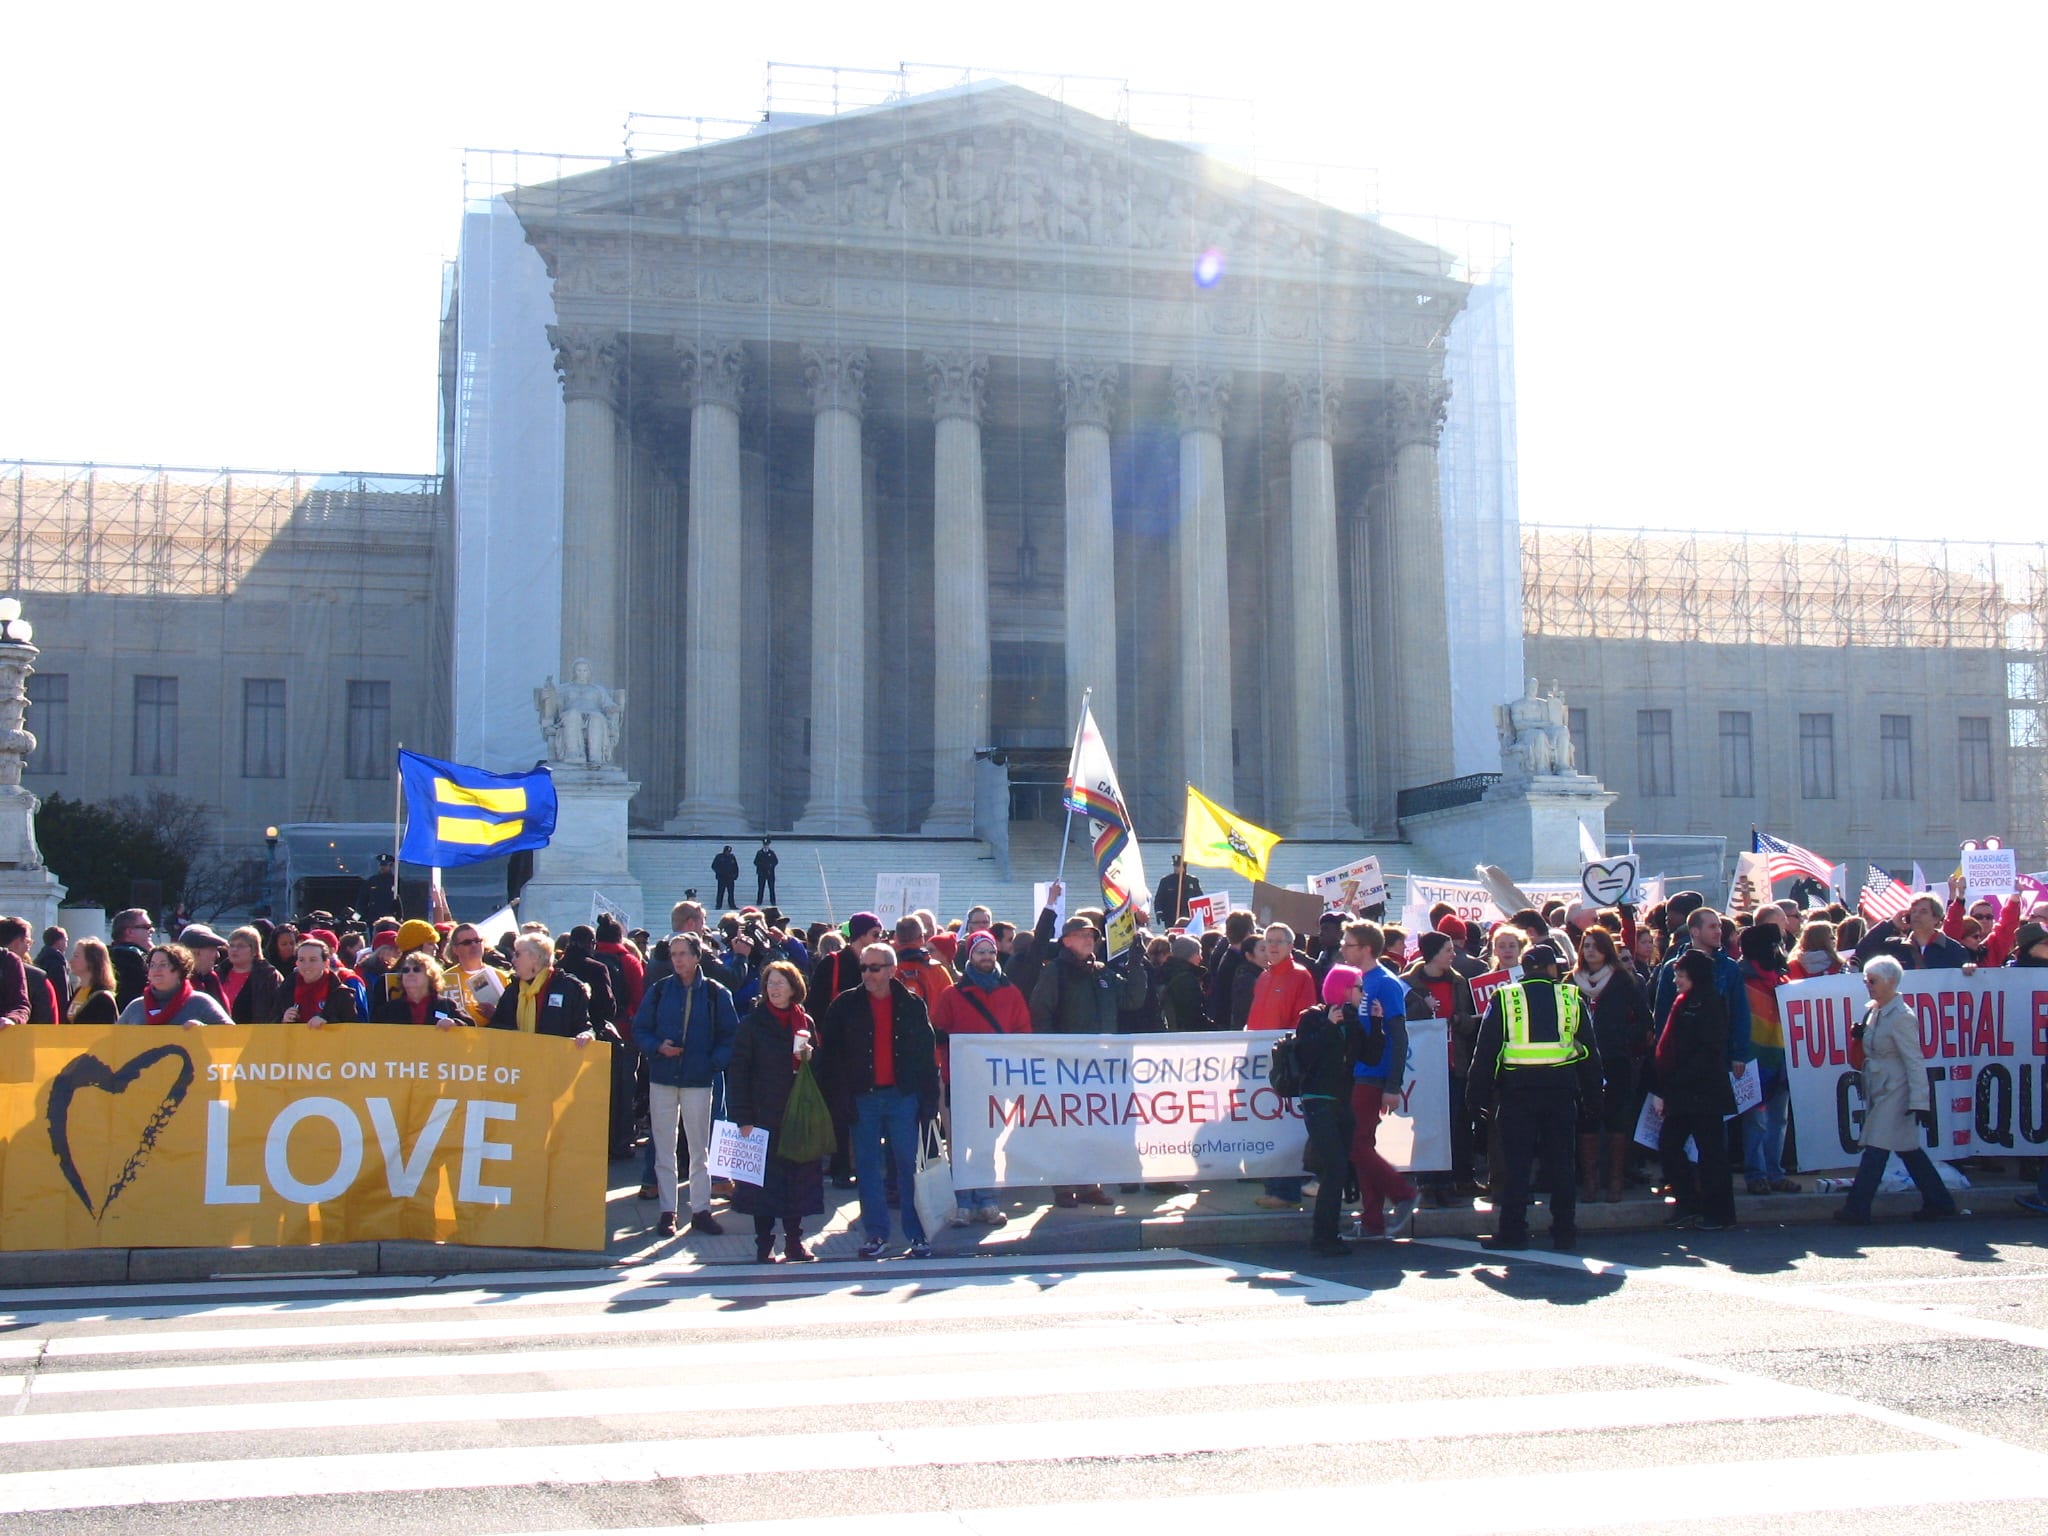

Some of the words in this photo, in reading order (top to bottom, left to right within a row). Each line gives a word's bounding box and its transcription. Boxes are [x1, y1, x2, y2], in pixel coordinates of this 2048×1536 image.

[1968, 854, 2009, 864] MARRIAGE
[1969, 870, 1999, 878] FREEDOM
[1969, 877, 2012, 887] EVERYONE
[1511, 991, 1522, 1023] USCP
[1561, 985, 1572, 1034] POLICE
[1902, 991, 2014, 1060] DERAL
[206, 1062, 332, 1081] STANDING
[341, 1061, 376, 1080] ON
[384, 1060, 430, 1080] THE
[437, 1063, 487, 1083] SIDE
[494, 1067, 521, 1085] OF
[986, 1057, 1047, 1086] THE
[1057, 1057, 1185, 1085] NATION
[1195, 1055, 1222, 1083] IS
[988, 1090, 1206, 1129] MARRIAGE
[204, 1096, 517, 1205] LOVE
[718, 1146, 752, 1160] FREEDOM
[719, 1138, 749, 1150] FREEDOM
[1138, 1138, 1275, 1156] UnitedforMarriage
[717, 1154, 762, 1175] EVERYON
